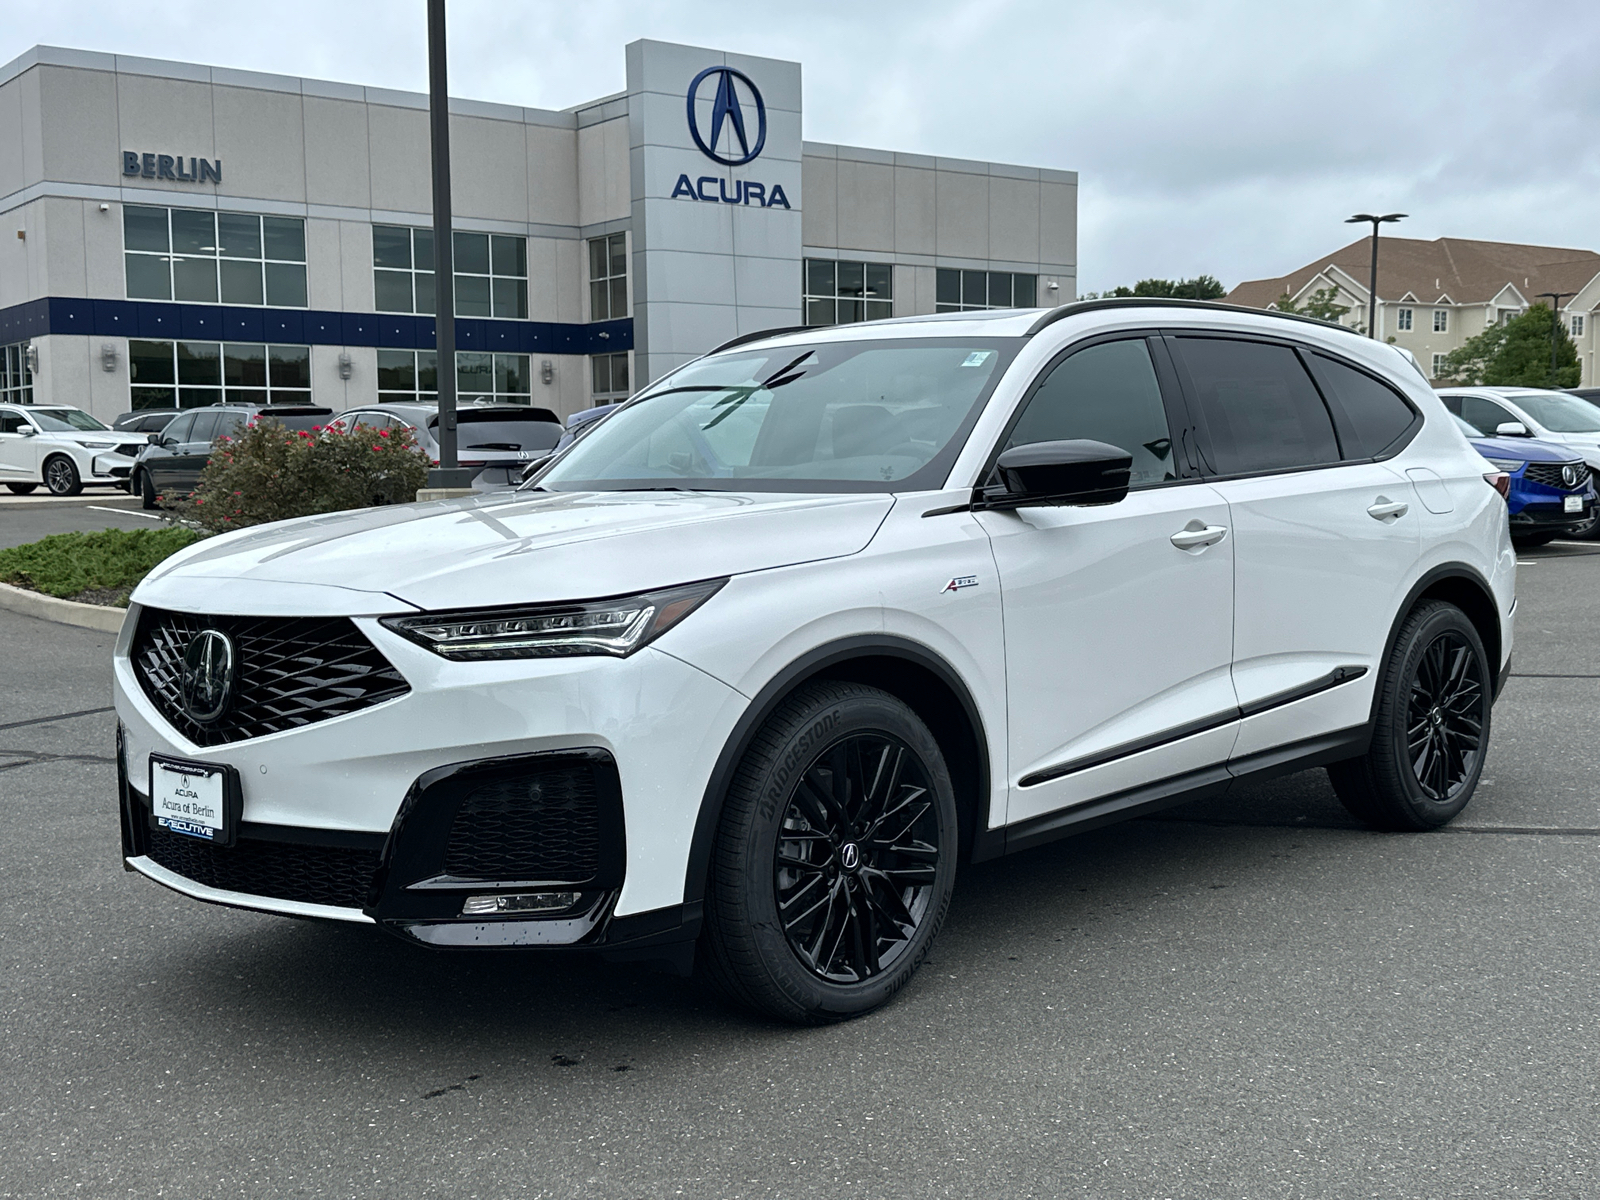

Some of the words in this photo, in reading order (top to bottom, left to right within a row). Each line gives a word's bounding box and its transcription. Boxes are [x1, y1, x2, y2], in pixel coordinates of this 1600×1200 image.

[122, 150, 222, 184] BERLIN
[671, 173, 791, 209] ACURA
[759, 709, 841, 823] BRIDGESTONE
[174, 788, 199, 799] ACURA
[162, 797, 181, 812] Acura
[182, 803, 191, 814] of
[192, 803, 215, 818] Berlin
[158, 817, 214, 837] EXECUTIVE
